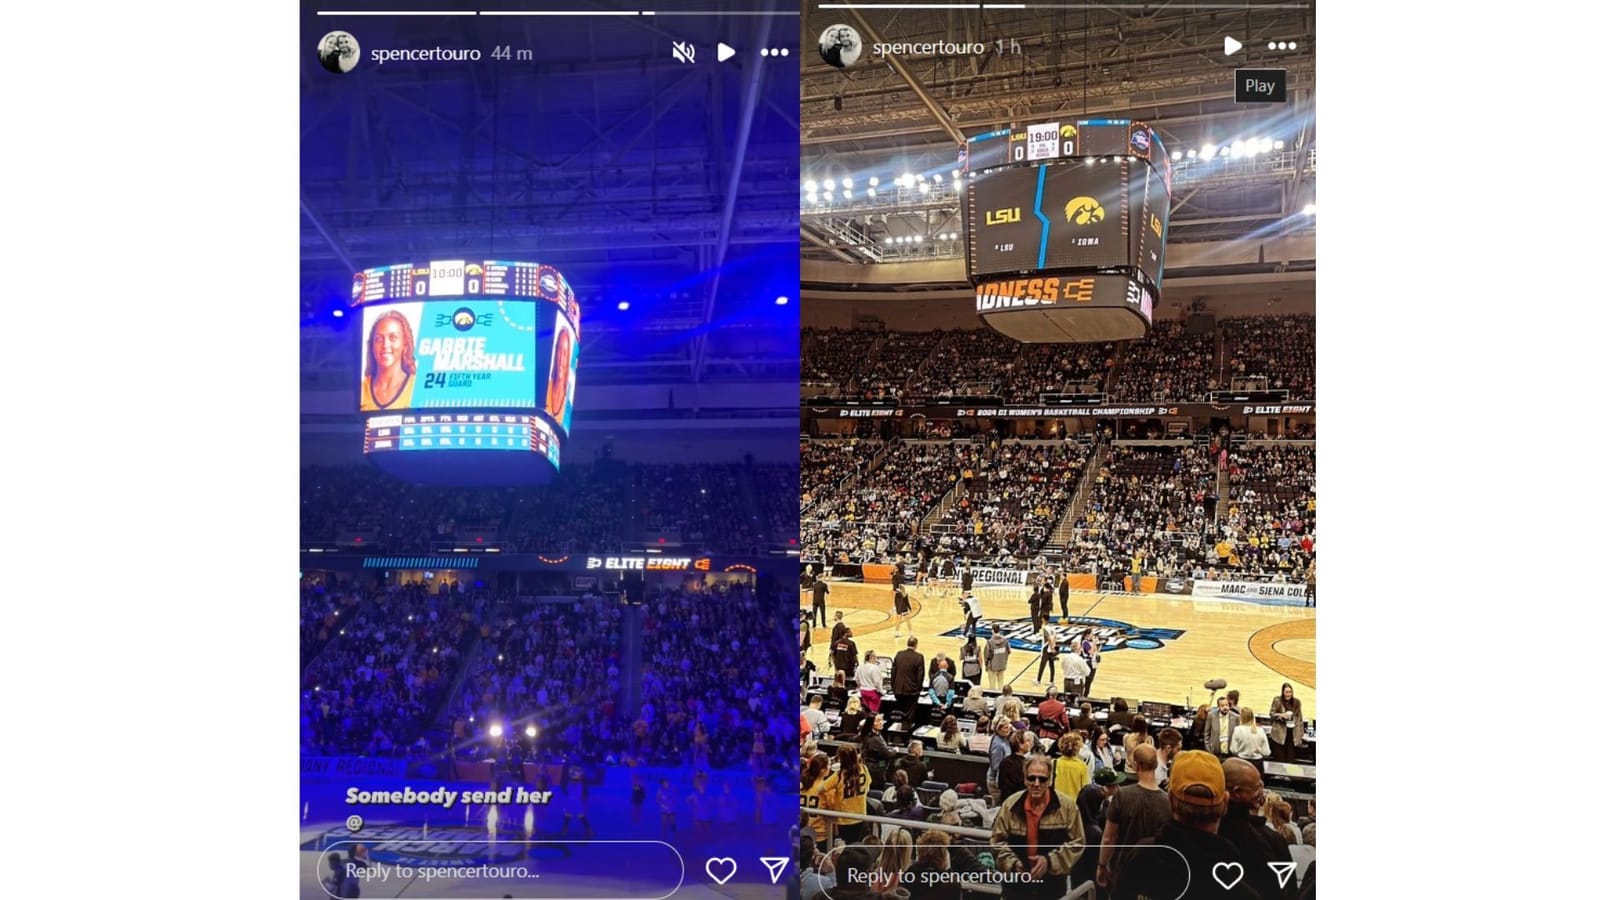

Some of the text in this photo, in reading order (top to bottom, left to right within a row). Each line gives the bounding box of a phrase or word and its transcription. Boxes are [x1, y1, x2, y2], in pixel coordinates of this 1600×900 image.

[1030, 131, 1058, 143] 19:00
[1015, 146, 1024, 161] 0
[1064, 141, 1073, 156] 0
[985, 207, 1021, 226] LSU
[1000, 243, 1014, 252] LSU
[1077, 237, 1099, 246] IOWA
[433, 268, 463, 279] 10:00
[415, 281, 426, 295] 0
[468, 279, 479, 294] 0
[433, 351, 526, 372] MARSHALL
[424, 372, 446, 389] 24
[449, 373, 471, 381] FIFTH
[448, 380, 472, 388] GUARD
[1043, 407, 1091, 416] BASKETBALL
[1092, 407, 1155, 416] CHAMPIONSHIP
[1255, 405, 1312, 414] ELITE EIGHT
[605, 557, 692, 570] ELITE EIGHT
[971, 569, 1024, 585] REGIONAL
[1221, 584, 1246, 594] MAAC
[1258, 585, 1284, 596] SIENA
